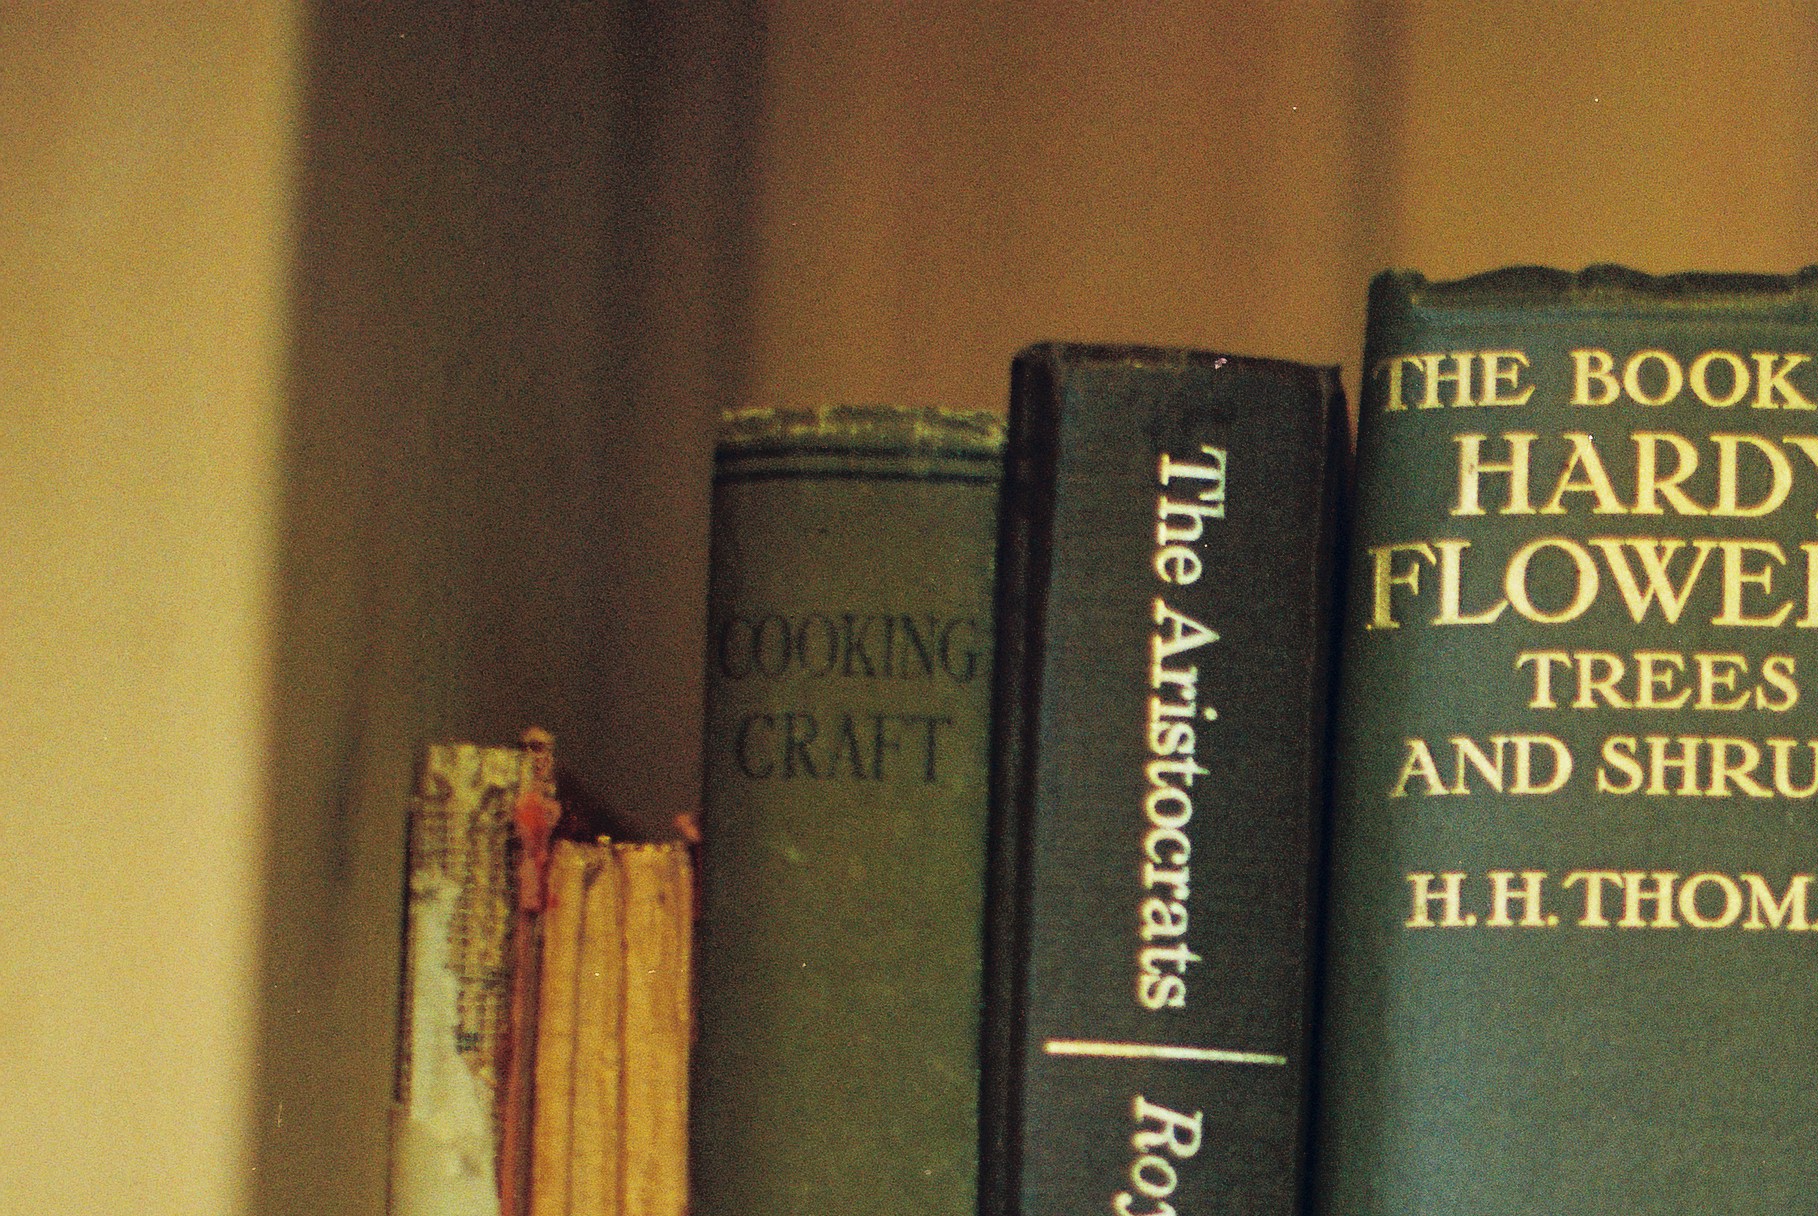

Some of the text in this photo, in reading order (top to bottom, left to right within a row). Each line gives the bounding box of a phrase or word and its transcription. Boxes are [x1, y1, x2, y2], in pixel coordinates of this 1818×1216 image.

[1375, 349, 1536, 411] THE
[1570, 348, 1817, 411] BOOK
[718, 613, 981, 683] COOKING
[1515, 650, 1798, 712] TREES
[735, 712, 952, 782] CRAFT
[1137, 445, 1228, 1012] The Aristocrats
[1389, 734, 1574, 798] AND
